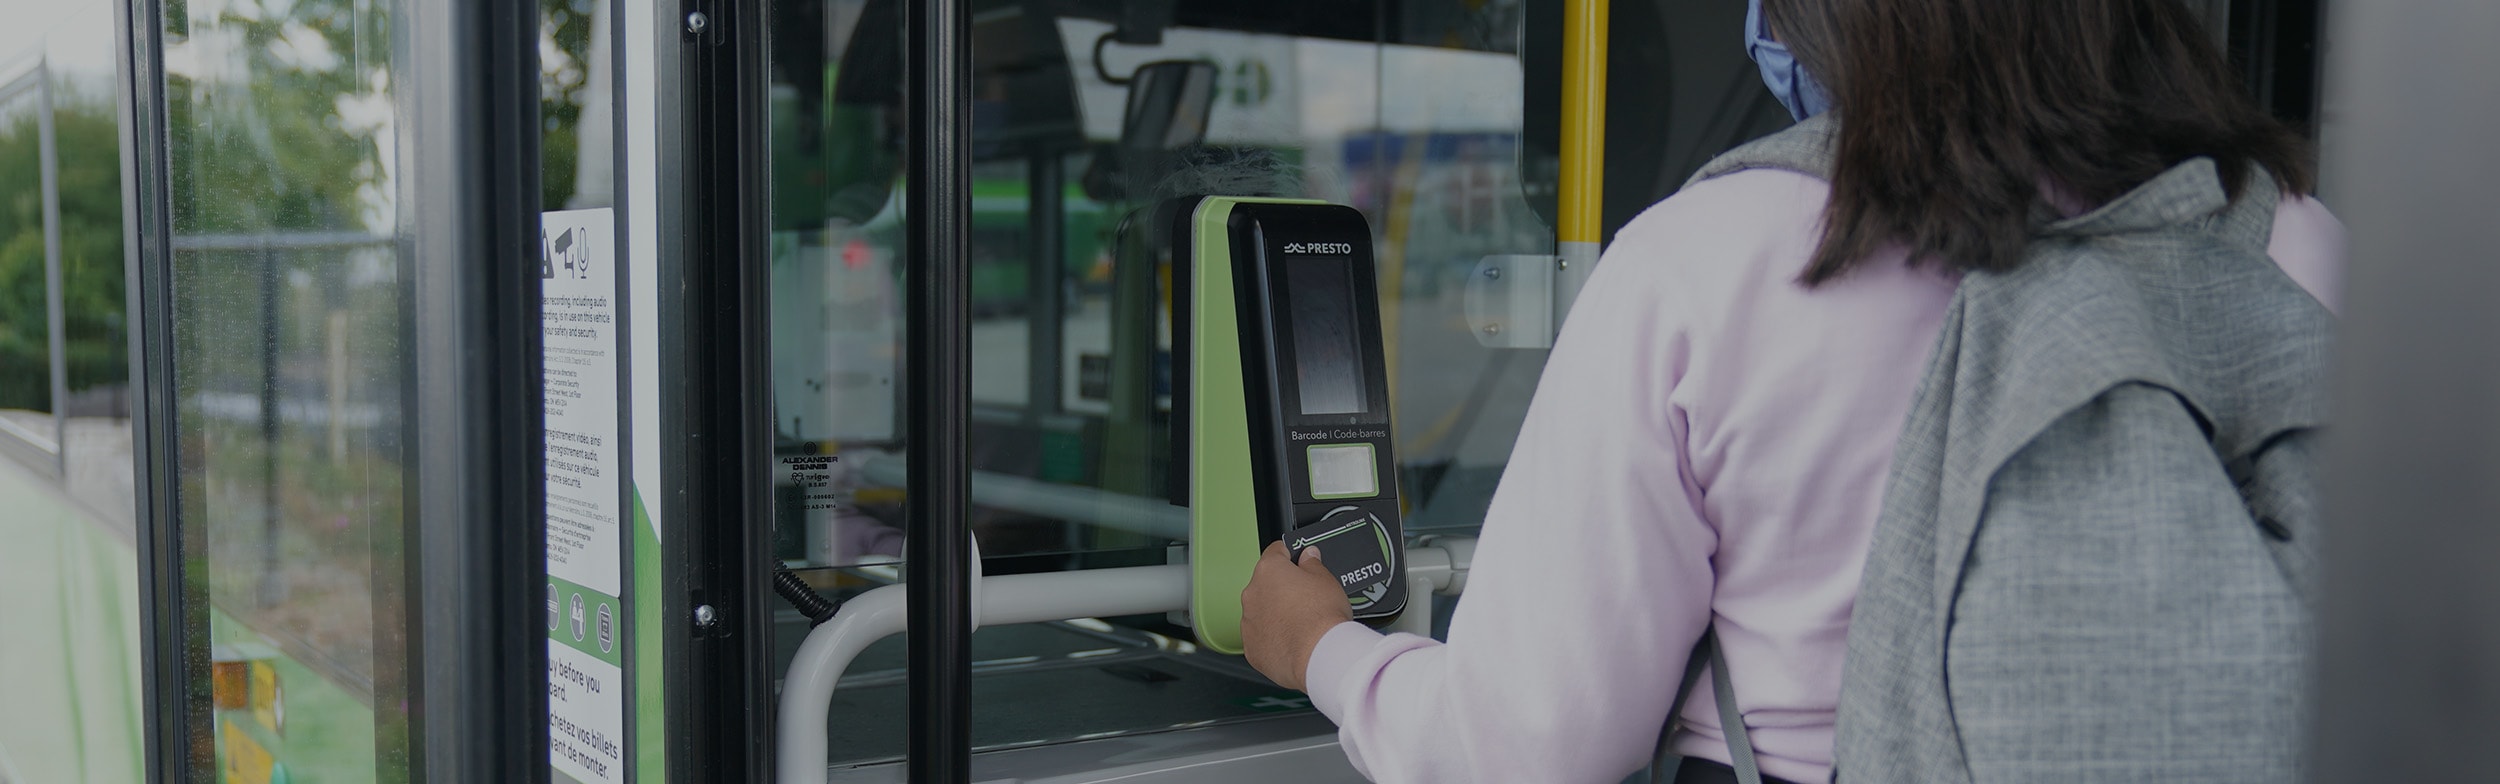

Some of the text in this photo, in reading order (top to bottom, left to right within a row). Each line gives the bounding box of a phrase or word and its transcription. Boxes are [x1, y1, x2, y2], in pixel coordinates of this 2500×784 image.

[1307, 242, 1352, 254] PRESTO
[1291, 430, 1328, 441] Barcode
[1334, 428, 1386, 439] Code-barres
[782, 456, 838, 464] ALEXANDER
[793, 463, 828, 471] DENNIS
[1340, 562, 1383, 587] PRESTO
[549, 657, 601, 694] uy before you
[549, 682, 567, 702] oard.
[550, 709, 618, 760] chetez vos billets
[550, 736, 609, 780] vant de monter.
